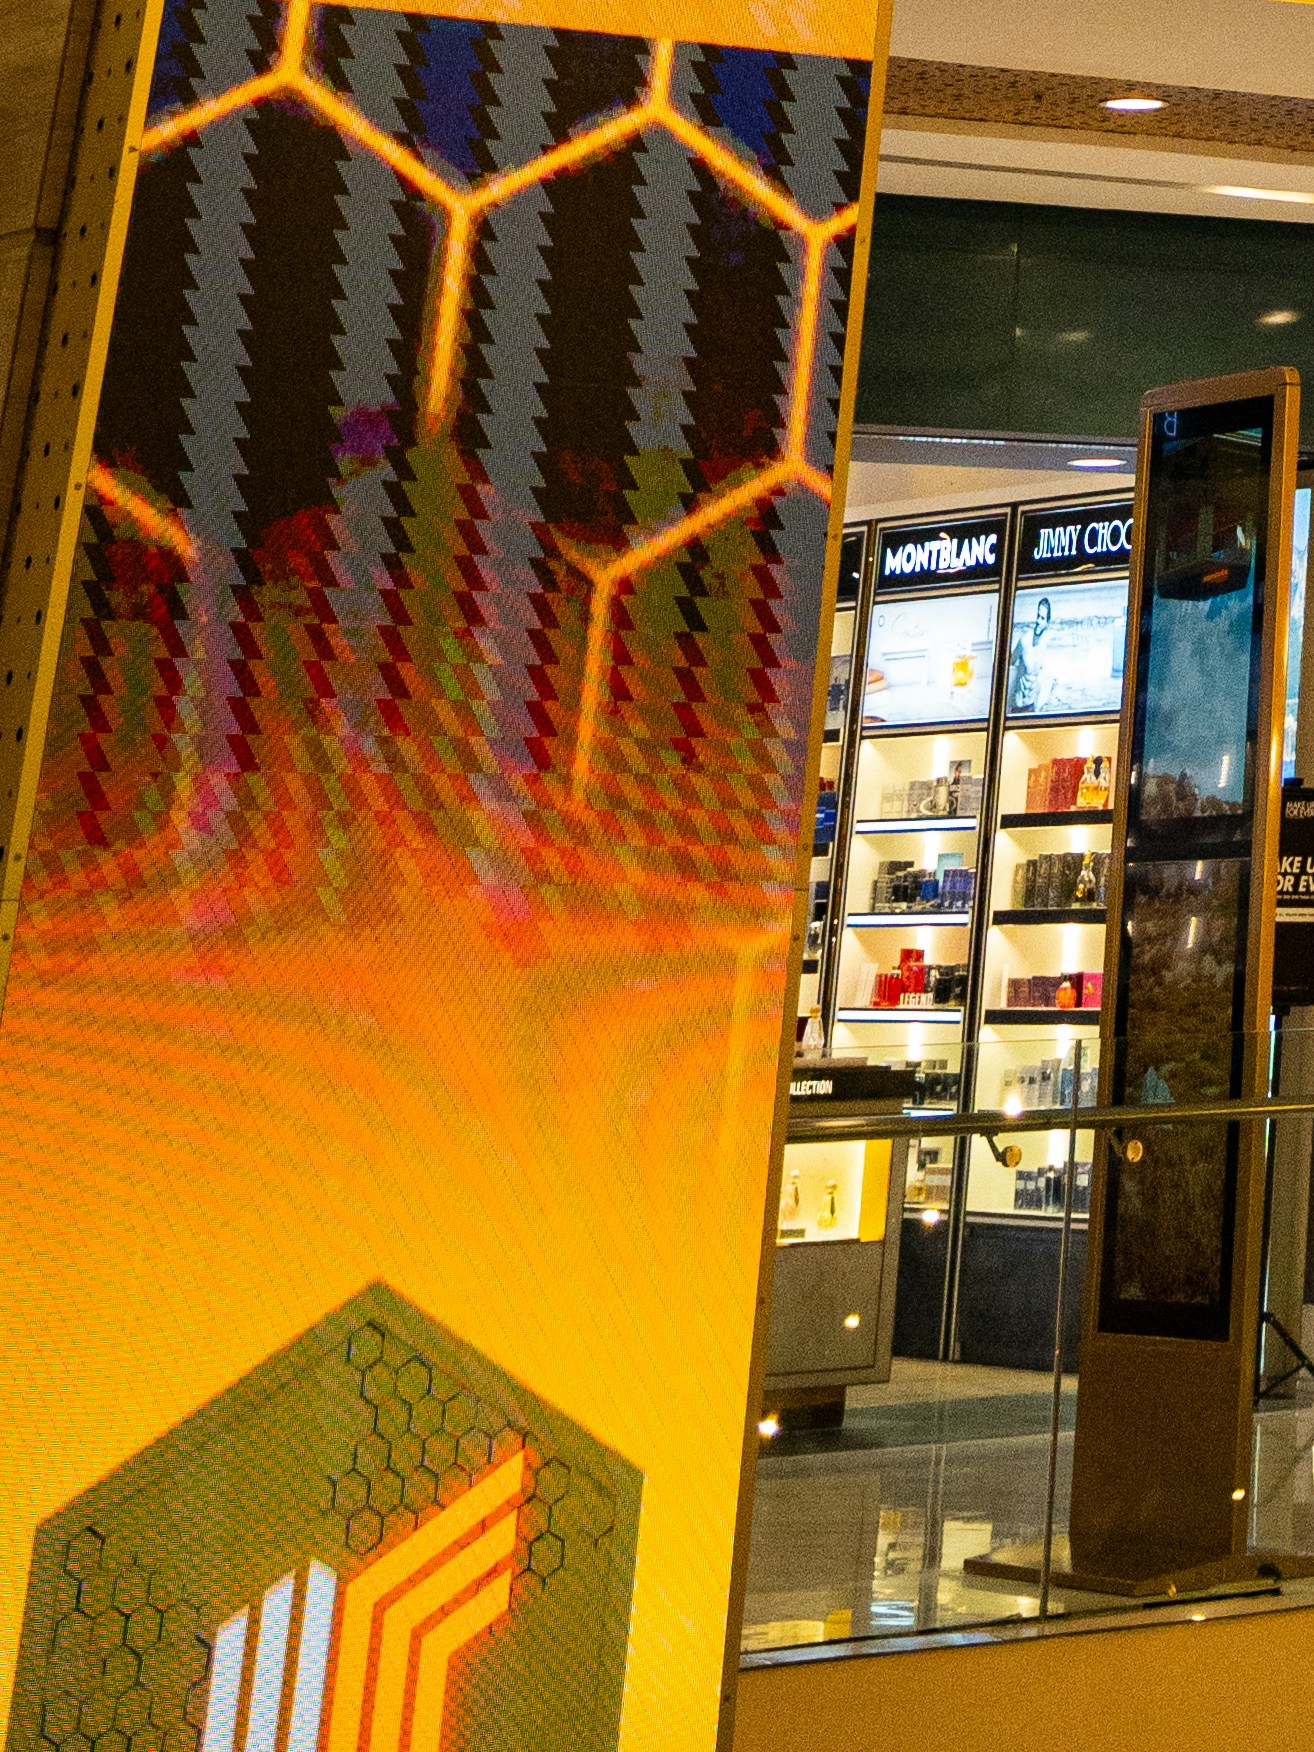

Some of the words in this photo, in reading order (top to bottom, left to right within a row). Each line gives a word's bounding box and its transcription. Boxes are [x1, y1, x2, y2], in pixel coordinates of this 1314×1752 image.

[884, 533, 998, 576] MONTBLANC
[1033, 525, 1082, 560] JIMMY
[1276, 875, 1295, 893] OR
[900, 992, 934, 1007] LEGEND
